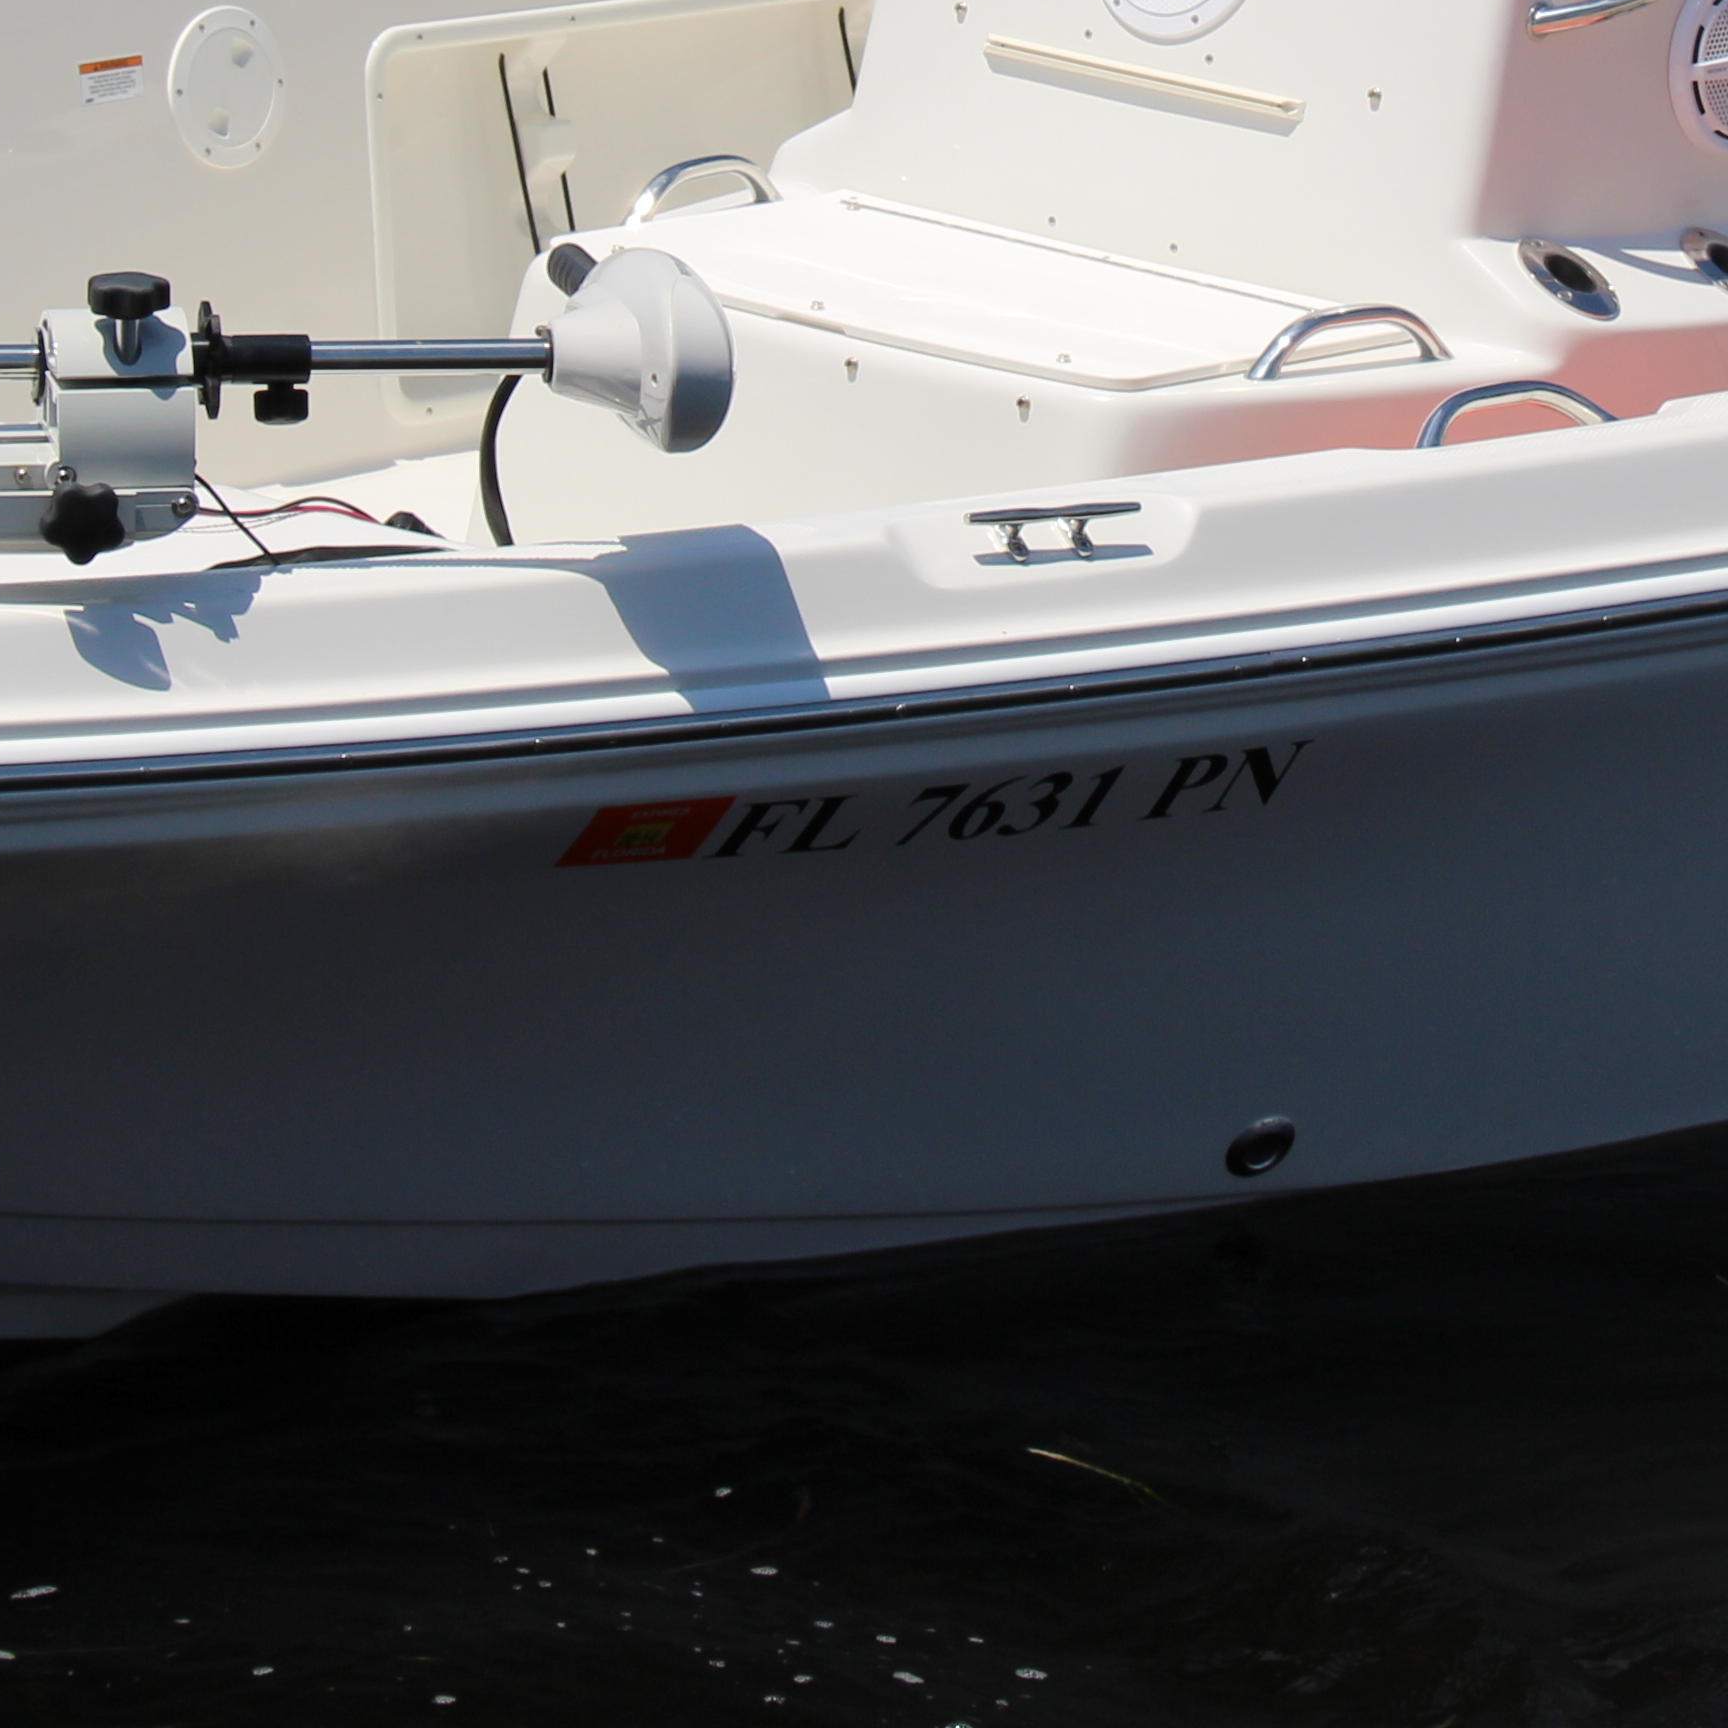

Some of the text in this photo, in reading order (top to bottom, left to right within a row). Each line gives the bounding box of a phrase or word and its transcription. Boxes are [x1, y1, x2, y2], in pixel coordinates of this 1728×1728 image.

[702, 739, 1314, 858] FL 7631 PN
